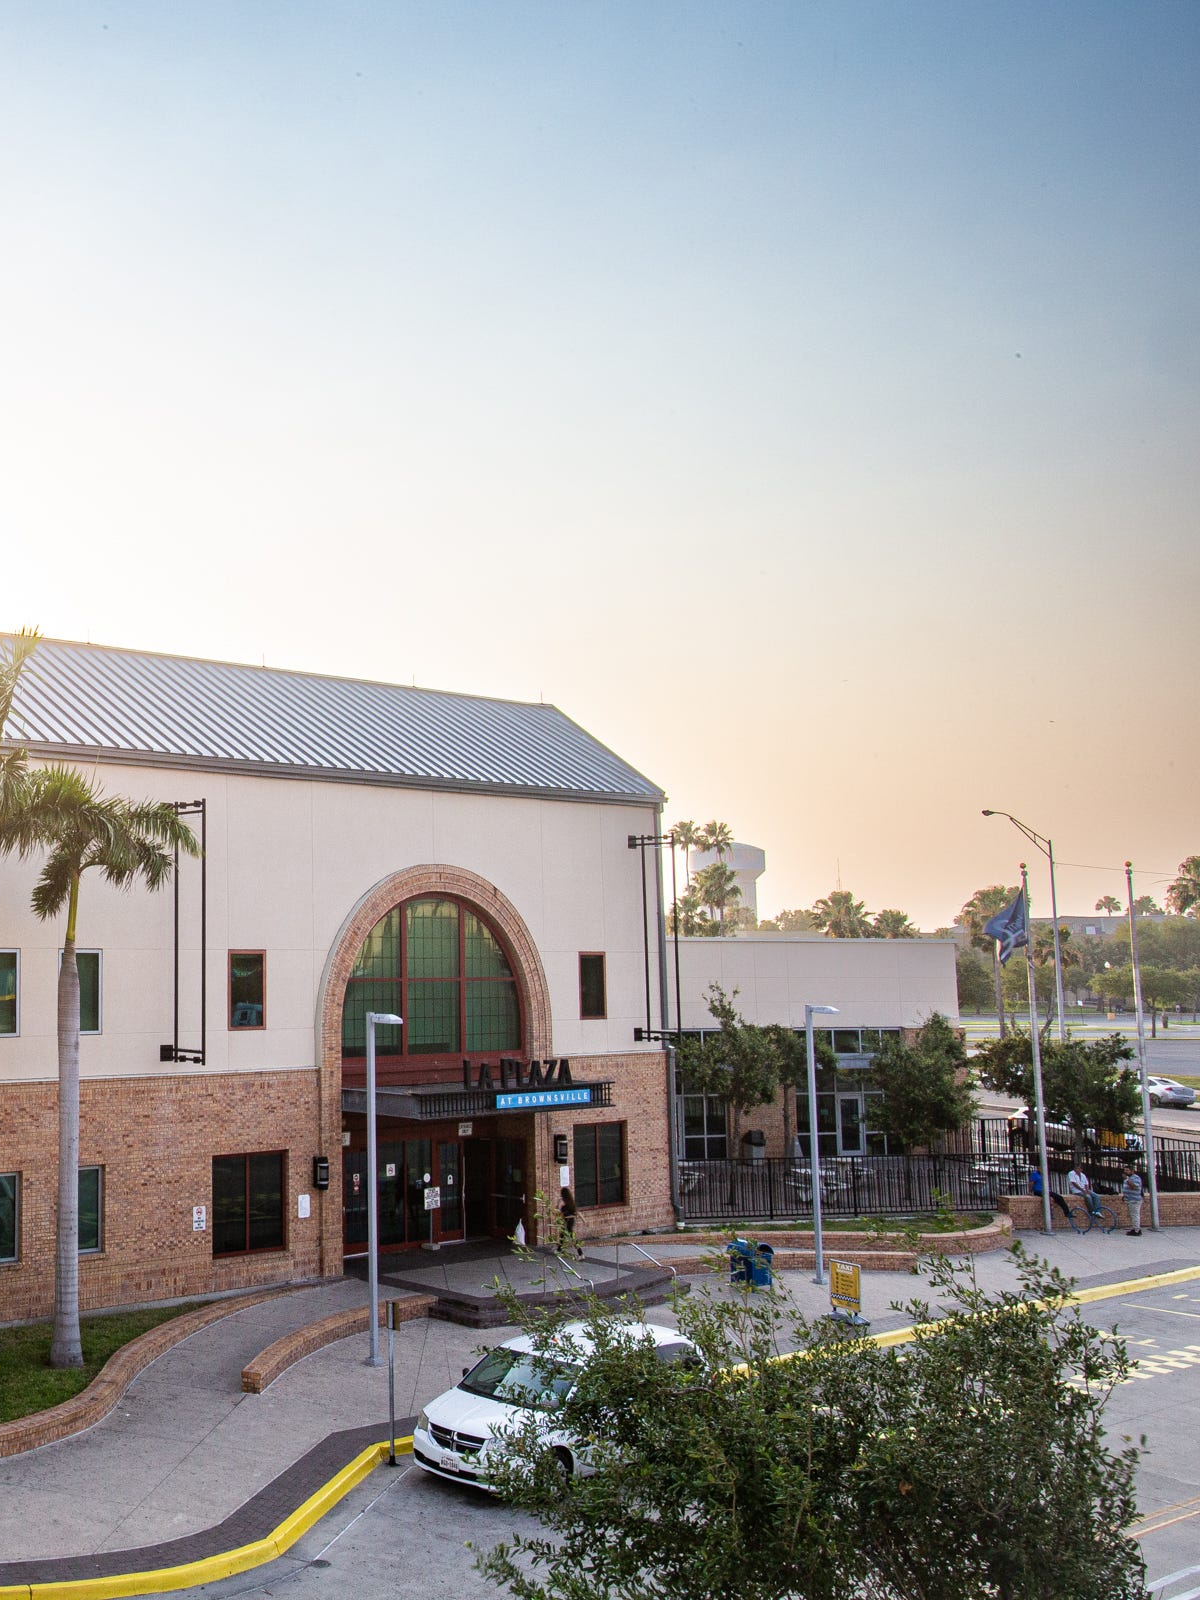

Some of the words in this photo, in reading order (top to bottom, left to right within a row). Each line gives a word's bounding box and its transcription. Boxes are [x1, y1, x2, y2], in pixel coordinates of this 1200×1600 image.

[463, 1059, 494, 1090] LA
[501, 1058, 573, 1089] PLAZA
[500, 1097, 511, 1105] AT
[518, 1091, 588, 1105] BROWNSVILLE
